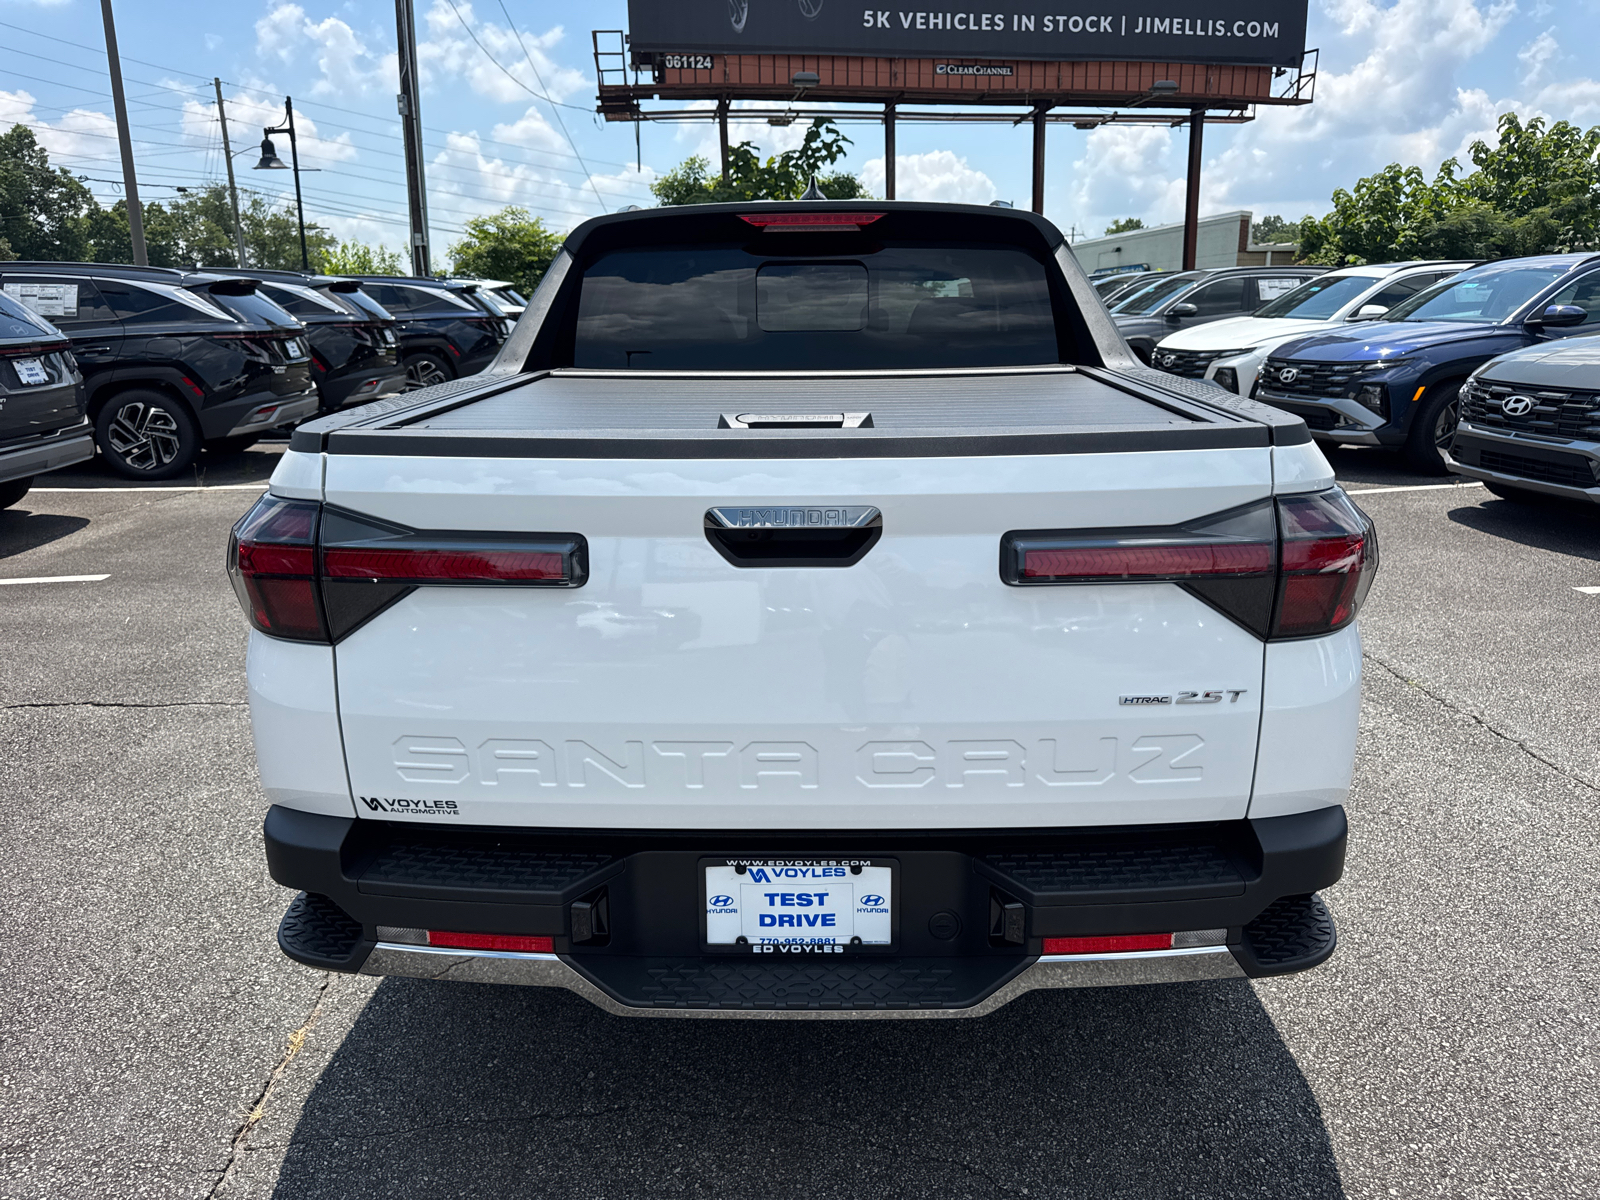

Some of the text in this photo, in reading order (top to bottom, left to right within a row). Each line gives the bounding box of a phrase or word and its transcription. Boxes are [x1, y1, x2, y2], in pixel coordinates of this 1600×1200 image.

[863, 10, 891, 28] 5K
[899, 11, 1005, 31] VEHICLES
[1013, 14, 1035, 31] IN
[1043, 15, 1113, 33] STOCK
[1135, 16, 1279, 38] JIMELLIS.COM
[665, 55, 712, 69] 061124
[739, 509, 847, 526] HYUNDAI
[1124, 696, 1169, 704] HTRAC
[392, 733, 1205, 788] SANTA CRUZ
[383, 798, 458, 809] VOYLES
[390, 807, 460, 815] AUTOMOTIVE
[772, 867, 846, 878] VOYLES
[764, 892, 829, 907] TEST
[759, 913, 836, 927] DRIVE
[759, 937, 836, 945] 770-952-8881
[752, 945, 844, 953] ED VOYLES
